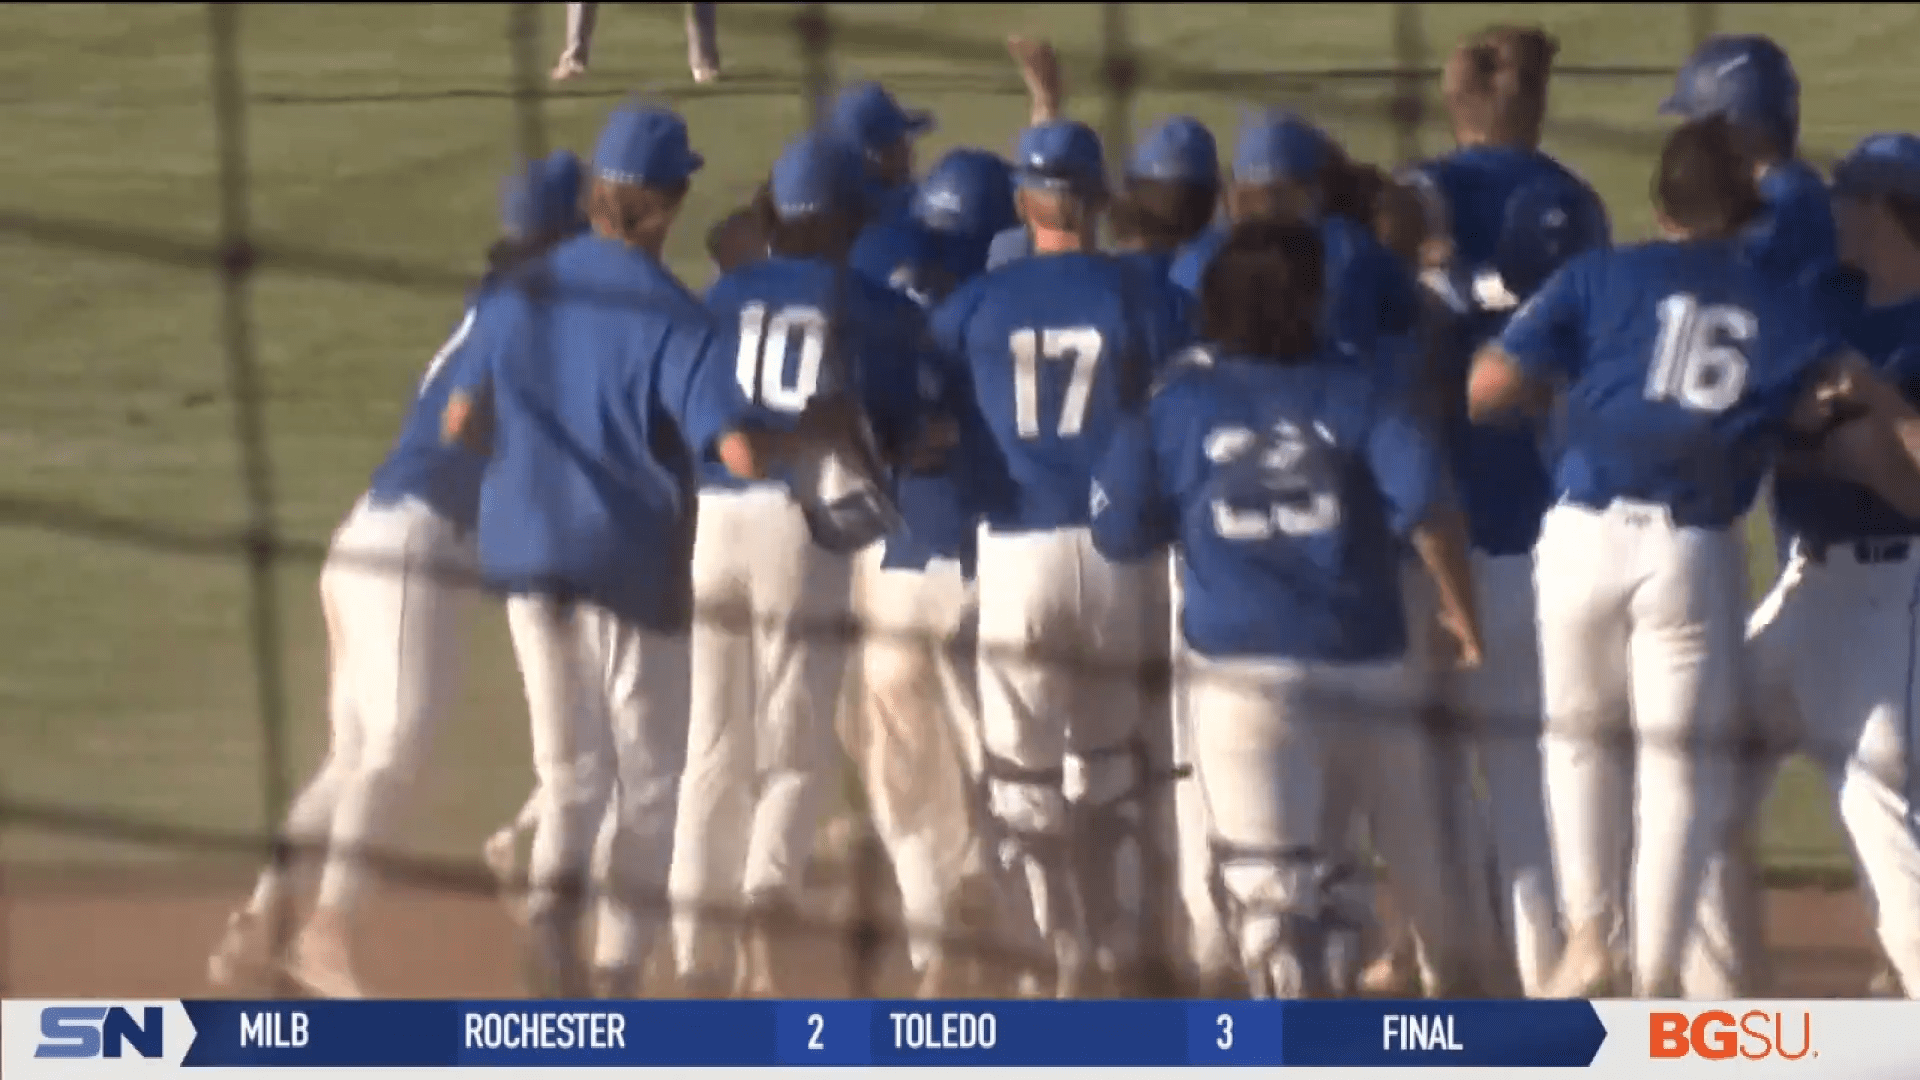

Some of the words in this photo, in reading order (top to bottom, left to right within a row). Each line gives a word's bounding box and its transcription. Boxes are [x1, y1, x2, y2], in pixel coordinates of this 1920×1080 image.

[736, 302, 828, 412] 10
[1008, 326, 1103, 438] 17
[1643, 293, 1759, 412] 16
